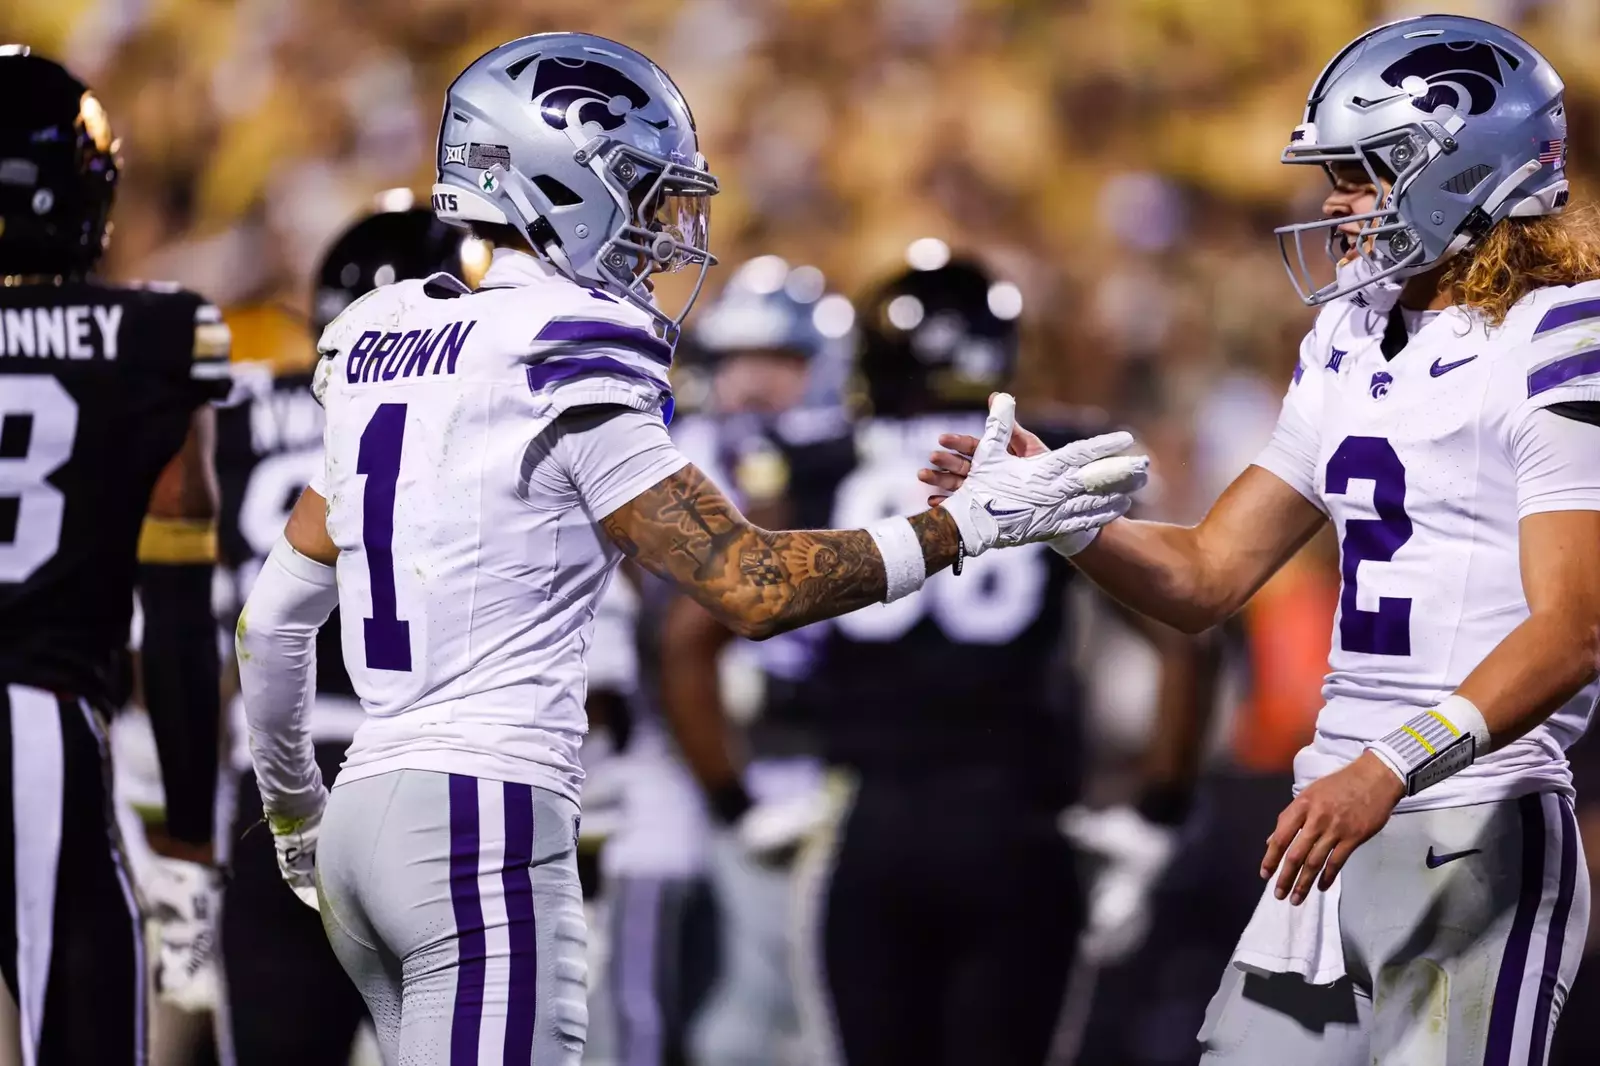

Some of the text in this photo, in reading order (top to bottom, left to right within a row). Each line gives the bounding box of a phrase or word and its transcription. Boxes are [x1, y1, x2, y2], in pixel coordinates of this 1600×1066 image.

[346, 320, 477, 384] BROWN
[356, 403, 412, 672] 1
[1325, 435, 1413, 656] 2
